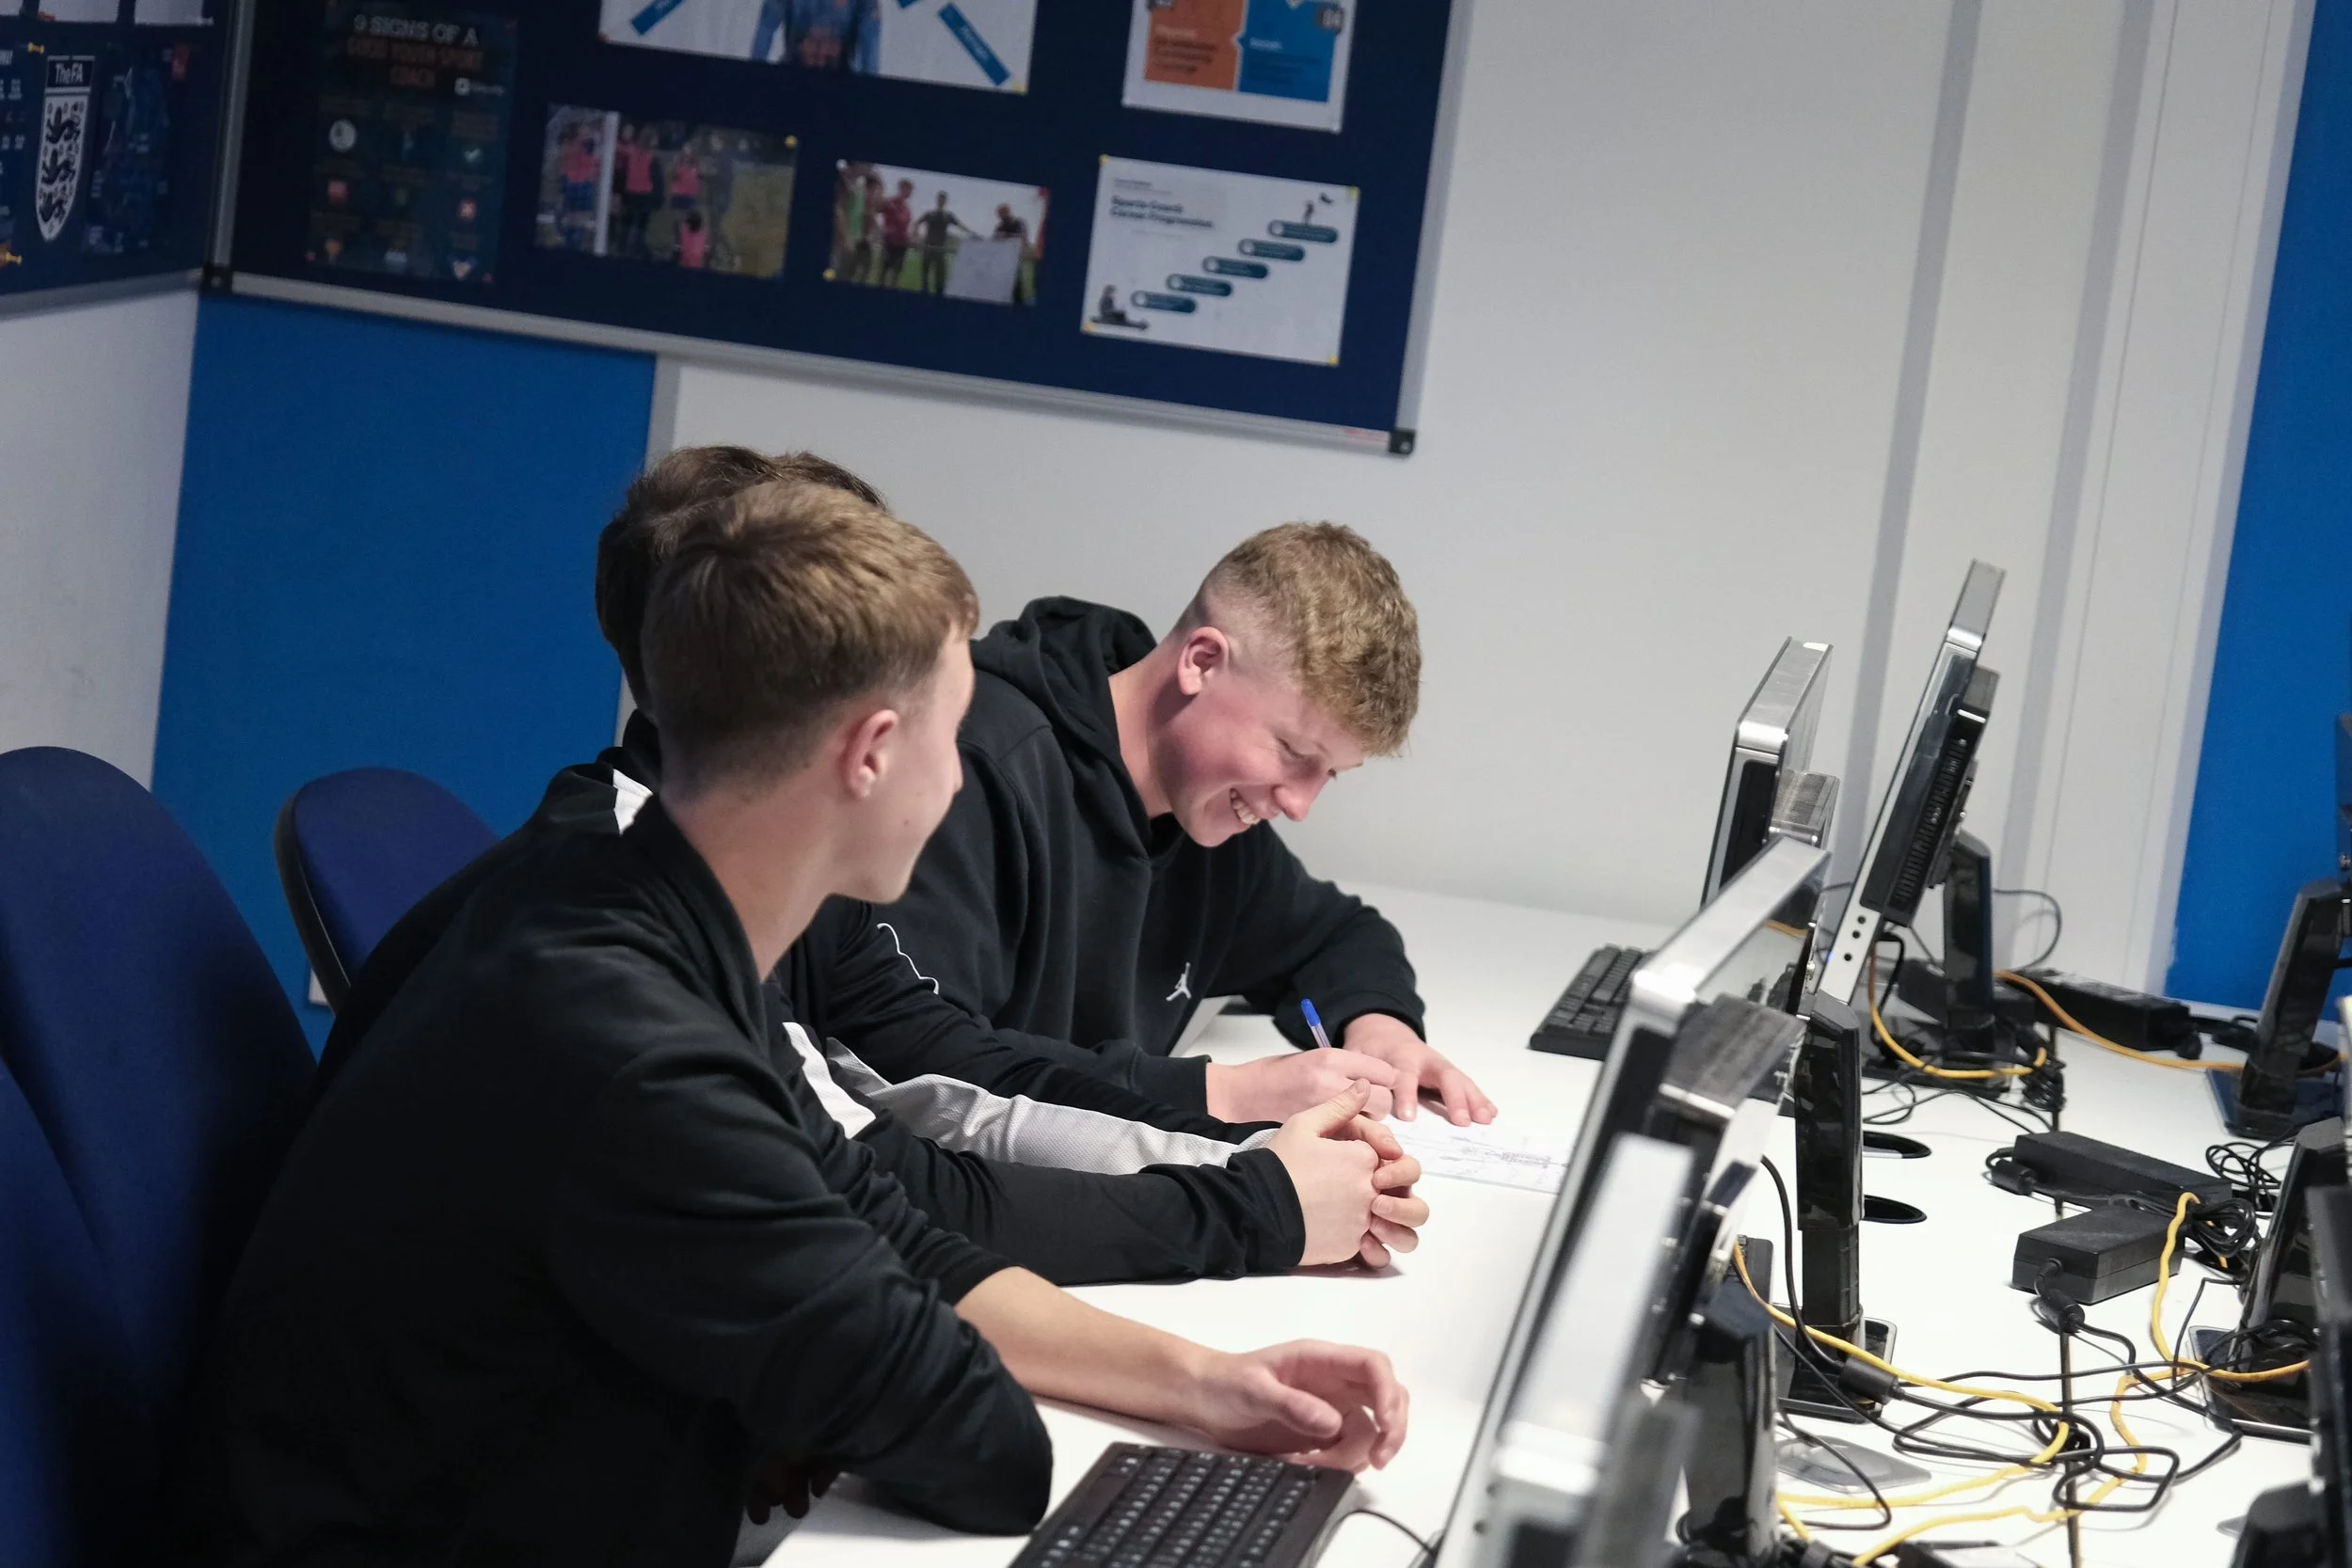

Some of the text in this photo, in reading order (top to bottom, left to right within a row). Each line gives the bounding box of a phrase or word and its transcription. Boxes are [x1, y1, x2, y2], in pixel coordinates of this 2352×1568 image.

[354, 14, 479, 47] 9 SIGNS OF A
